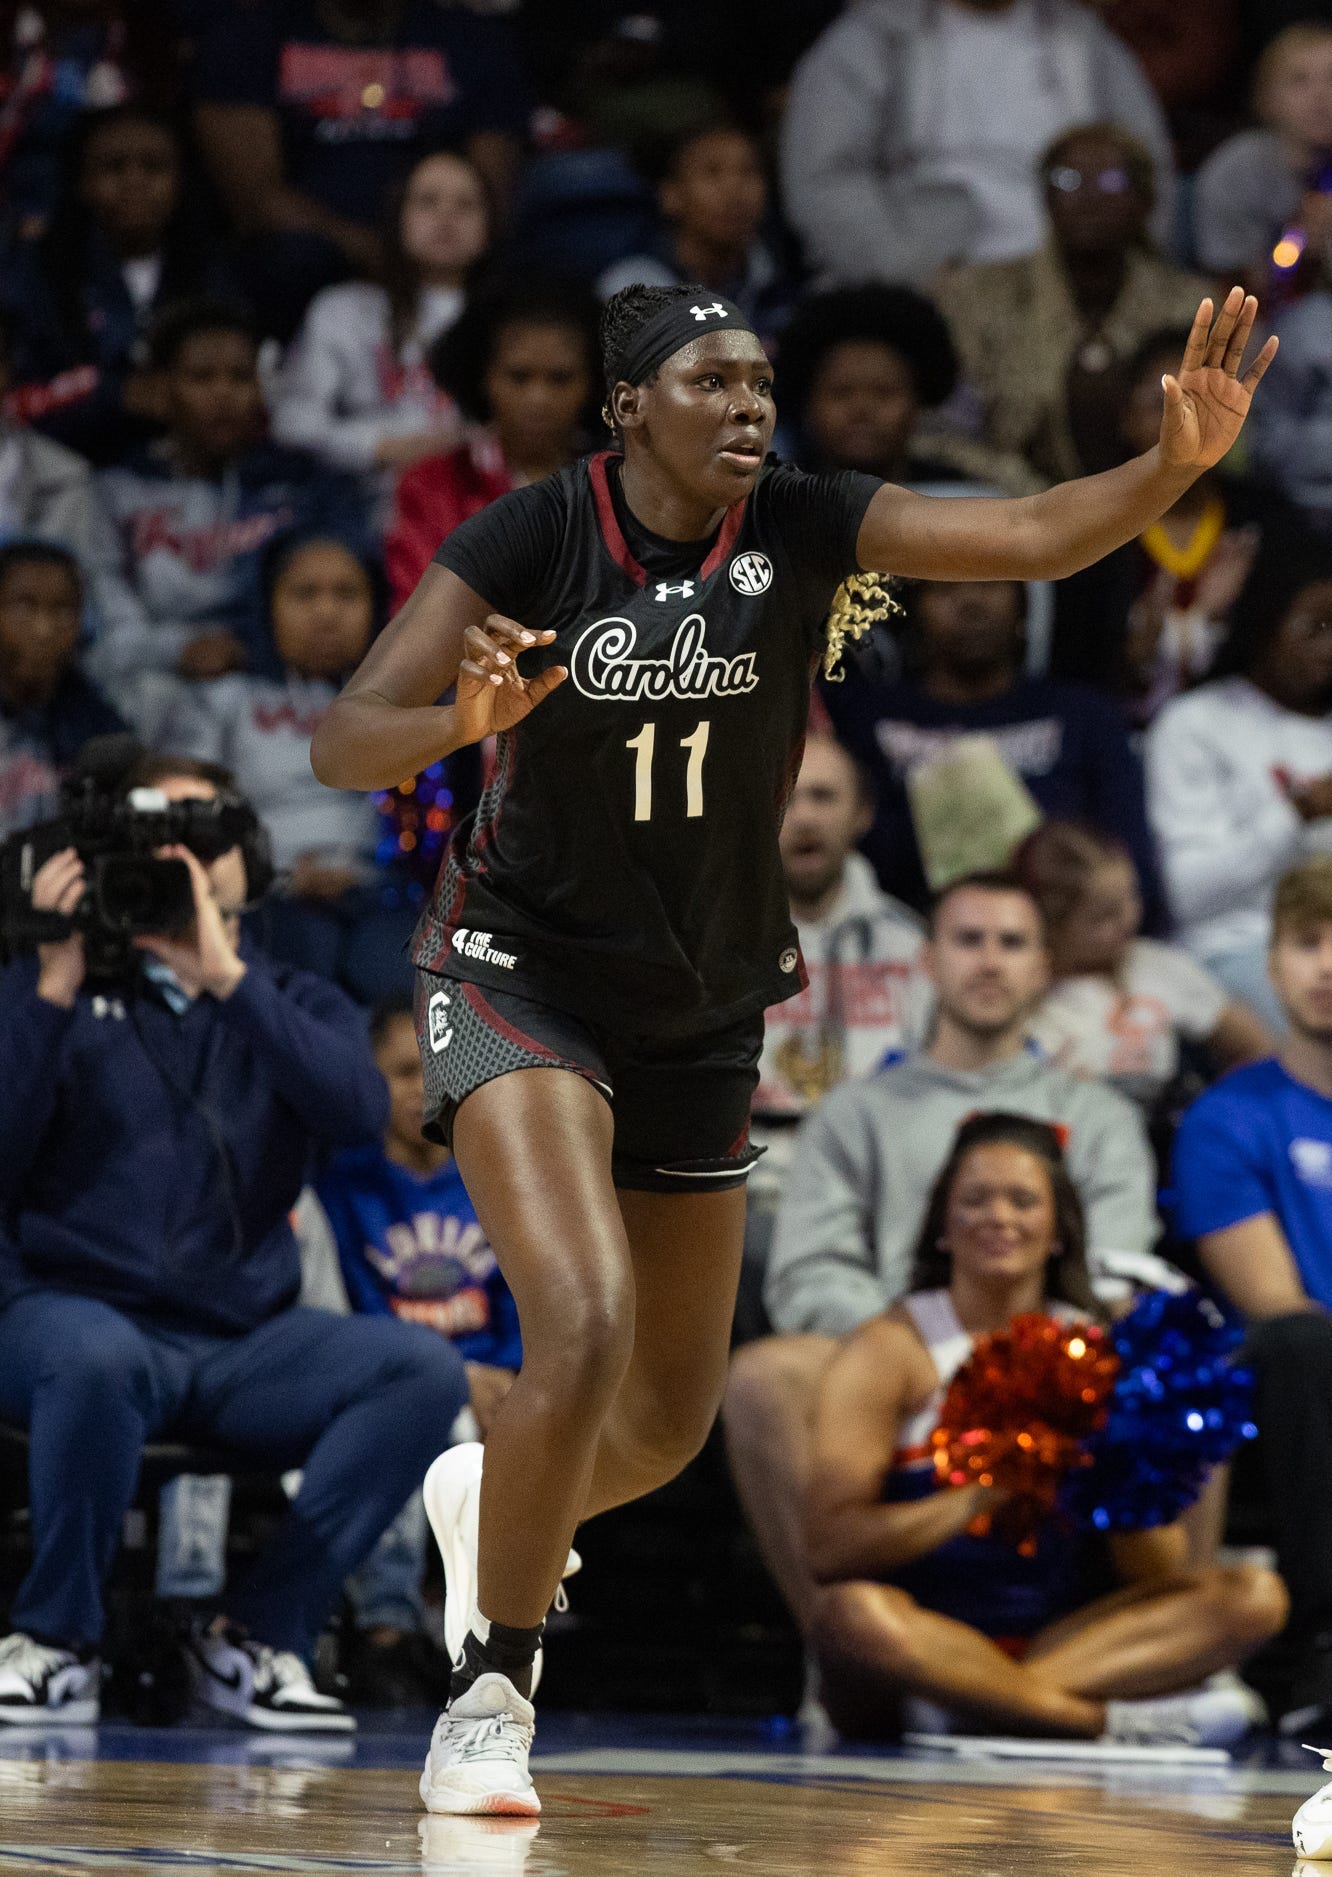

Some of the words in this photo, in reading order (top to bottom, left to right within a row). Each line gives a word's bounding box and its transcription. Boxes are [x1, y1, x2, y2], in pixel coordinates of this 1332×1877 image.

[732, 553, 770, 593] SEC
[571, 614, 759, 701] Carolina
[626, 720, 710, 821] 11
[451, 928, 470, 954] 4
[469, 930, 494, 949] THE
[464, 941, 518, 970] CULTURE
